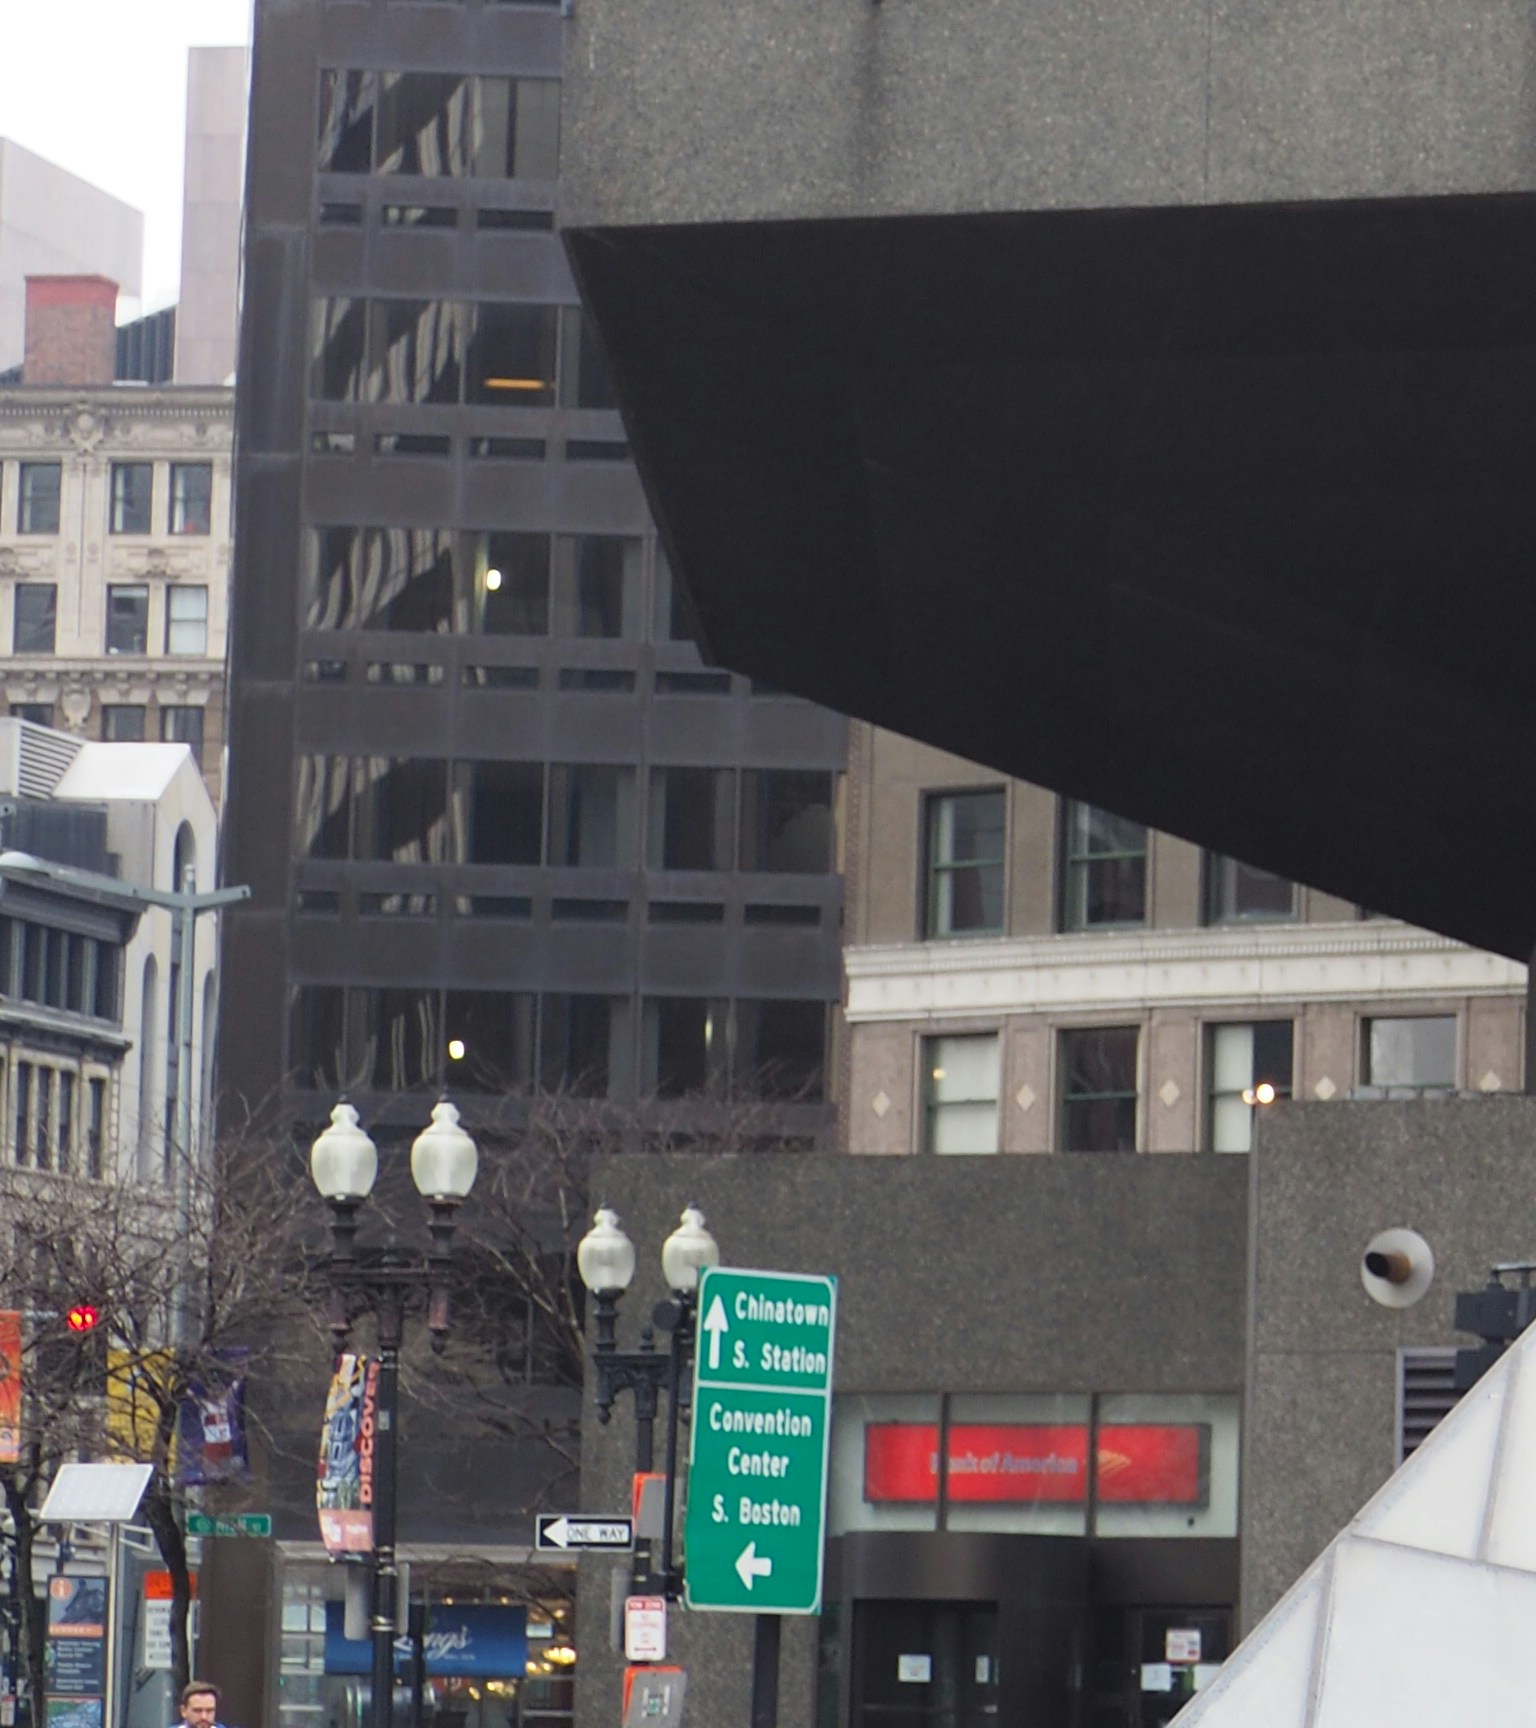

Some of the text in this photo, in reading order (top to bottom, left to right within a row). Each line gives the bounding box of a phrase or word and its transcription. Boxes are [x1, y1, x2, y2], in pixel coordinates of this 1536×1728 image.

[734, 1291, 829, 1327] Chinatown
[732, 1339, 826, 1374] S. Station
[709, 1402, 812, 1437] Convention
[728, 1446, 790, 1478] Center
[711, 1494, 800, 1527] S. Boston
[566, 1527, 626, 1540] ONE WAY
